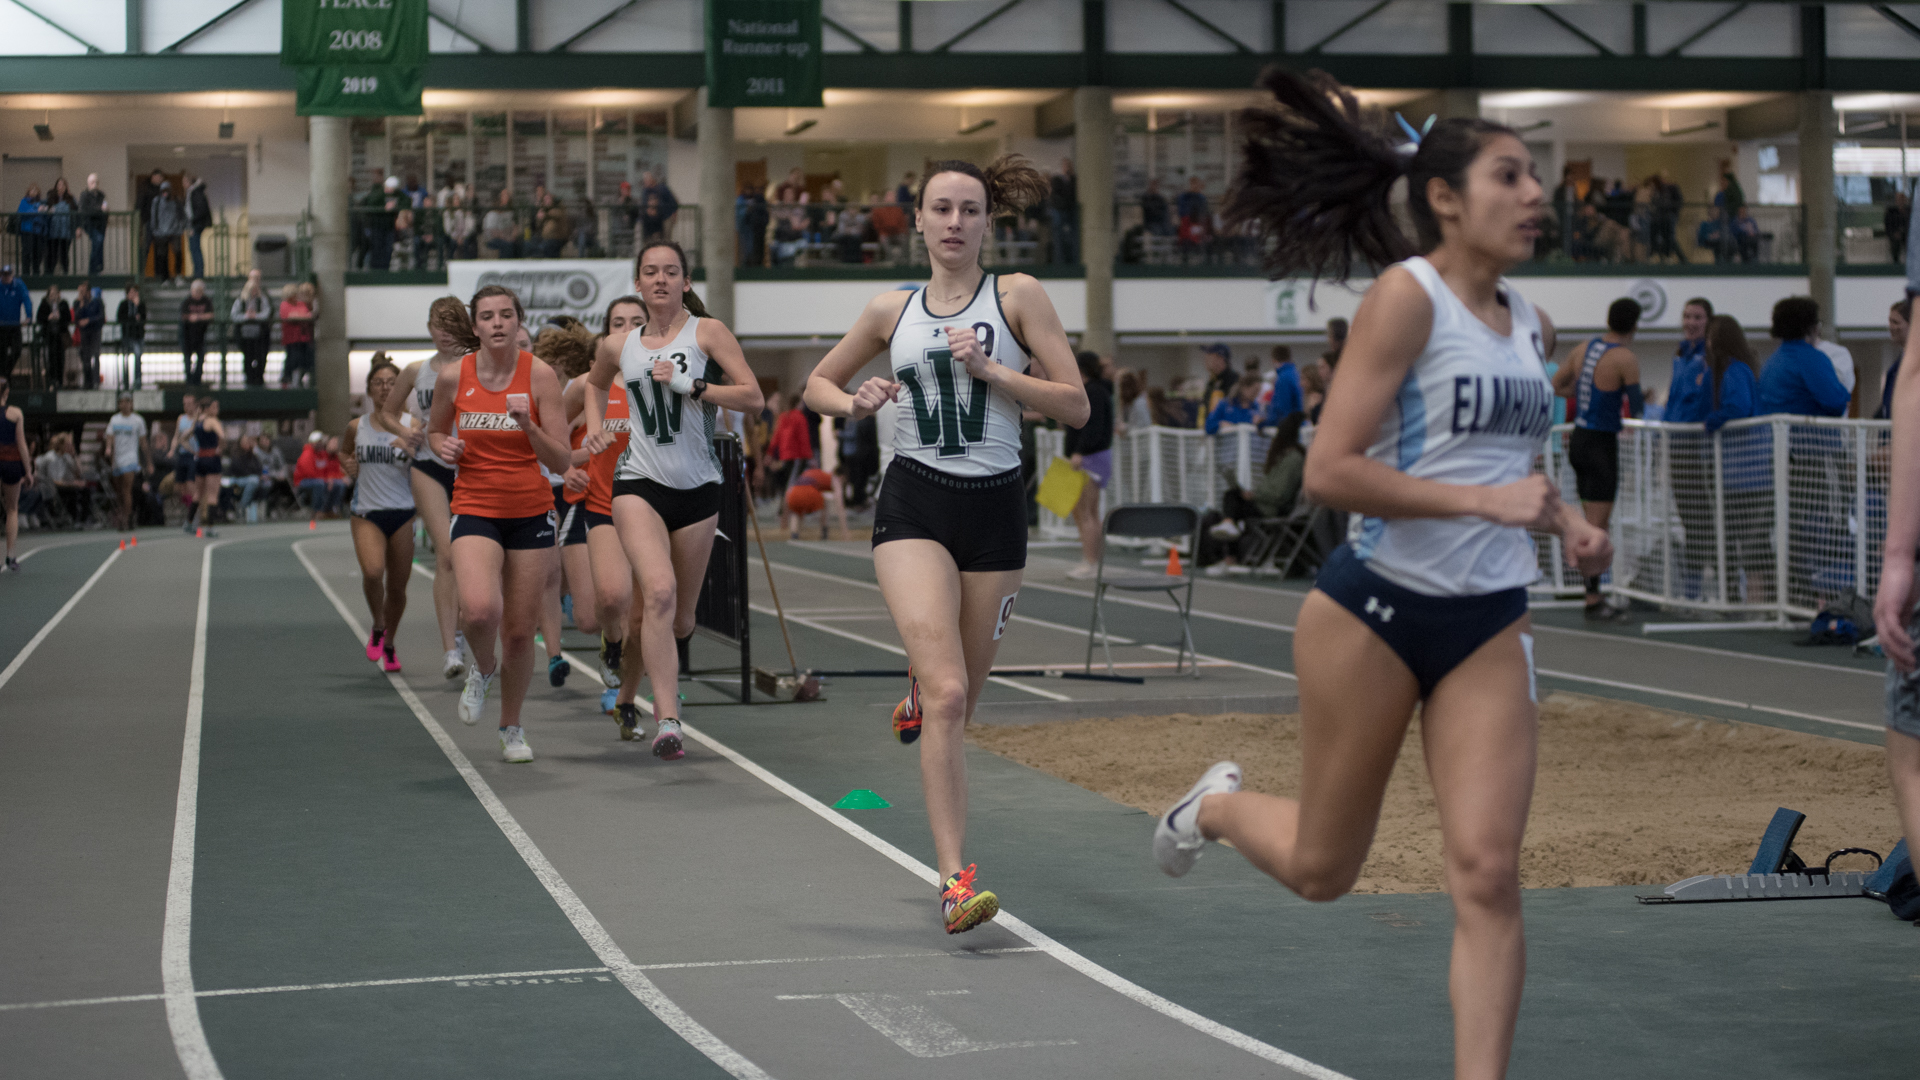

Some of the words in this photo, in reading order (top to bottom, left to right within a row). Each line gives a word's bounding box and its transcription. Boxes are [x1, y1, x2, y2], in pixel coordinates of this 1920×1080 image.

[728, 19, 798, 34] National
[328, 29, 383, 51] 2008
[722, 39, 810, 59] Runner-up
[341, 76, 378, 94] 2019
[745, 78, 785, 95] 2011
[970, 321, 995, 357] 9
[669, 352, 688, 374] 3
[459, 412, 522, 431] WHEATO
[998, 596, 1015, 636] 9
